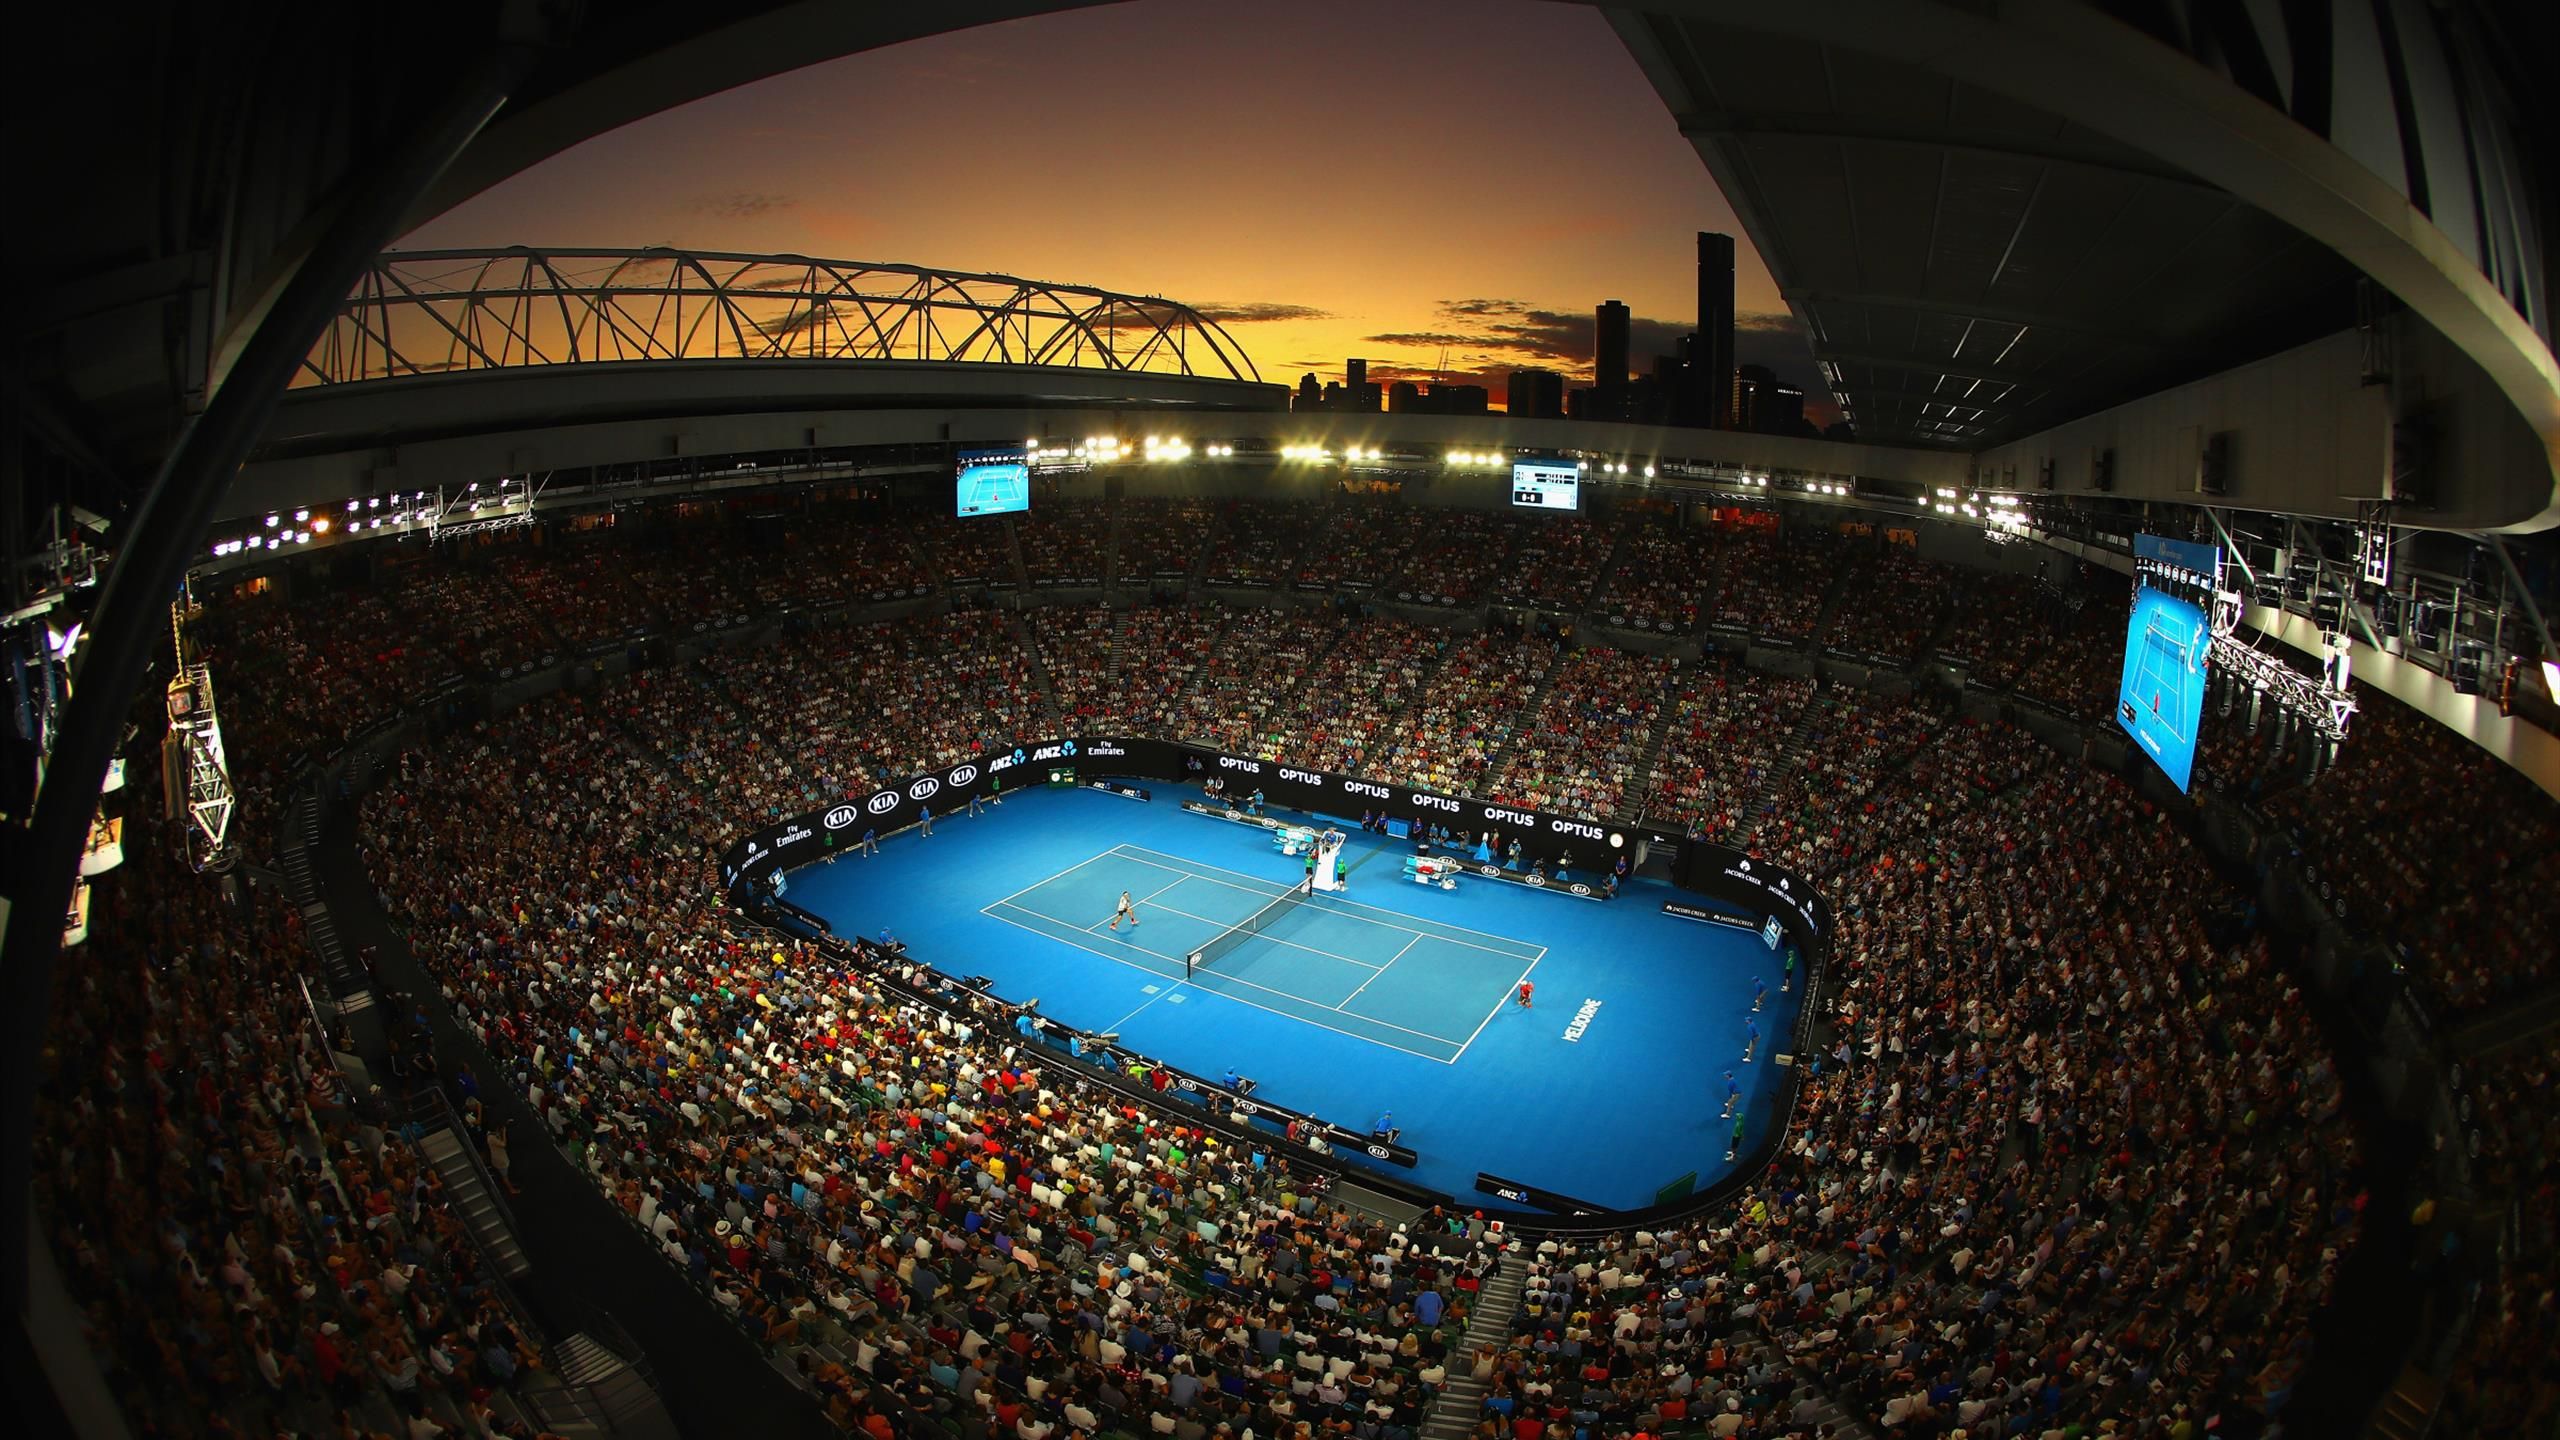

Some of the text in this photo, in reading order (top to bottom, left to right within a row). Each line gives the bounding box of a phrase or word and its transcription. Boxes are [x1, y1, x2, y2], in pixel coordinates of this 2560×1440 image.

[1032, 745, 1062, 761] ANZ
[1088, 747, 1125, 756] Emirates
[988, 755, 1013, 773] ANZ
[1220, 757, 1260, 773] OPTUS
[953, 768, 975, 784] KIA
[1280, 768, 1322, 785] OPTUS
[914, 780, 936, 797] KIA
[1344, 781, 1390, 798] OPTUS
[872, 794, 897, 812] KIA
[1412, 794, 1460, 812] OPTUS
[828, 808, 853, 826] KIA
[1484, 807, 1535, 826] OPTUS
[776, 828, 812, 847] Emirates
[1552, 820, 1604, 839] OPTUS
[1560, 998, 1602, 1042] MELBOURNE
[1497, 1188, 1518, 1200] ANZ
